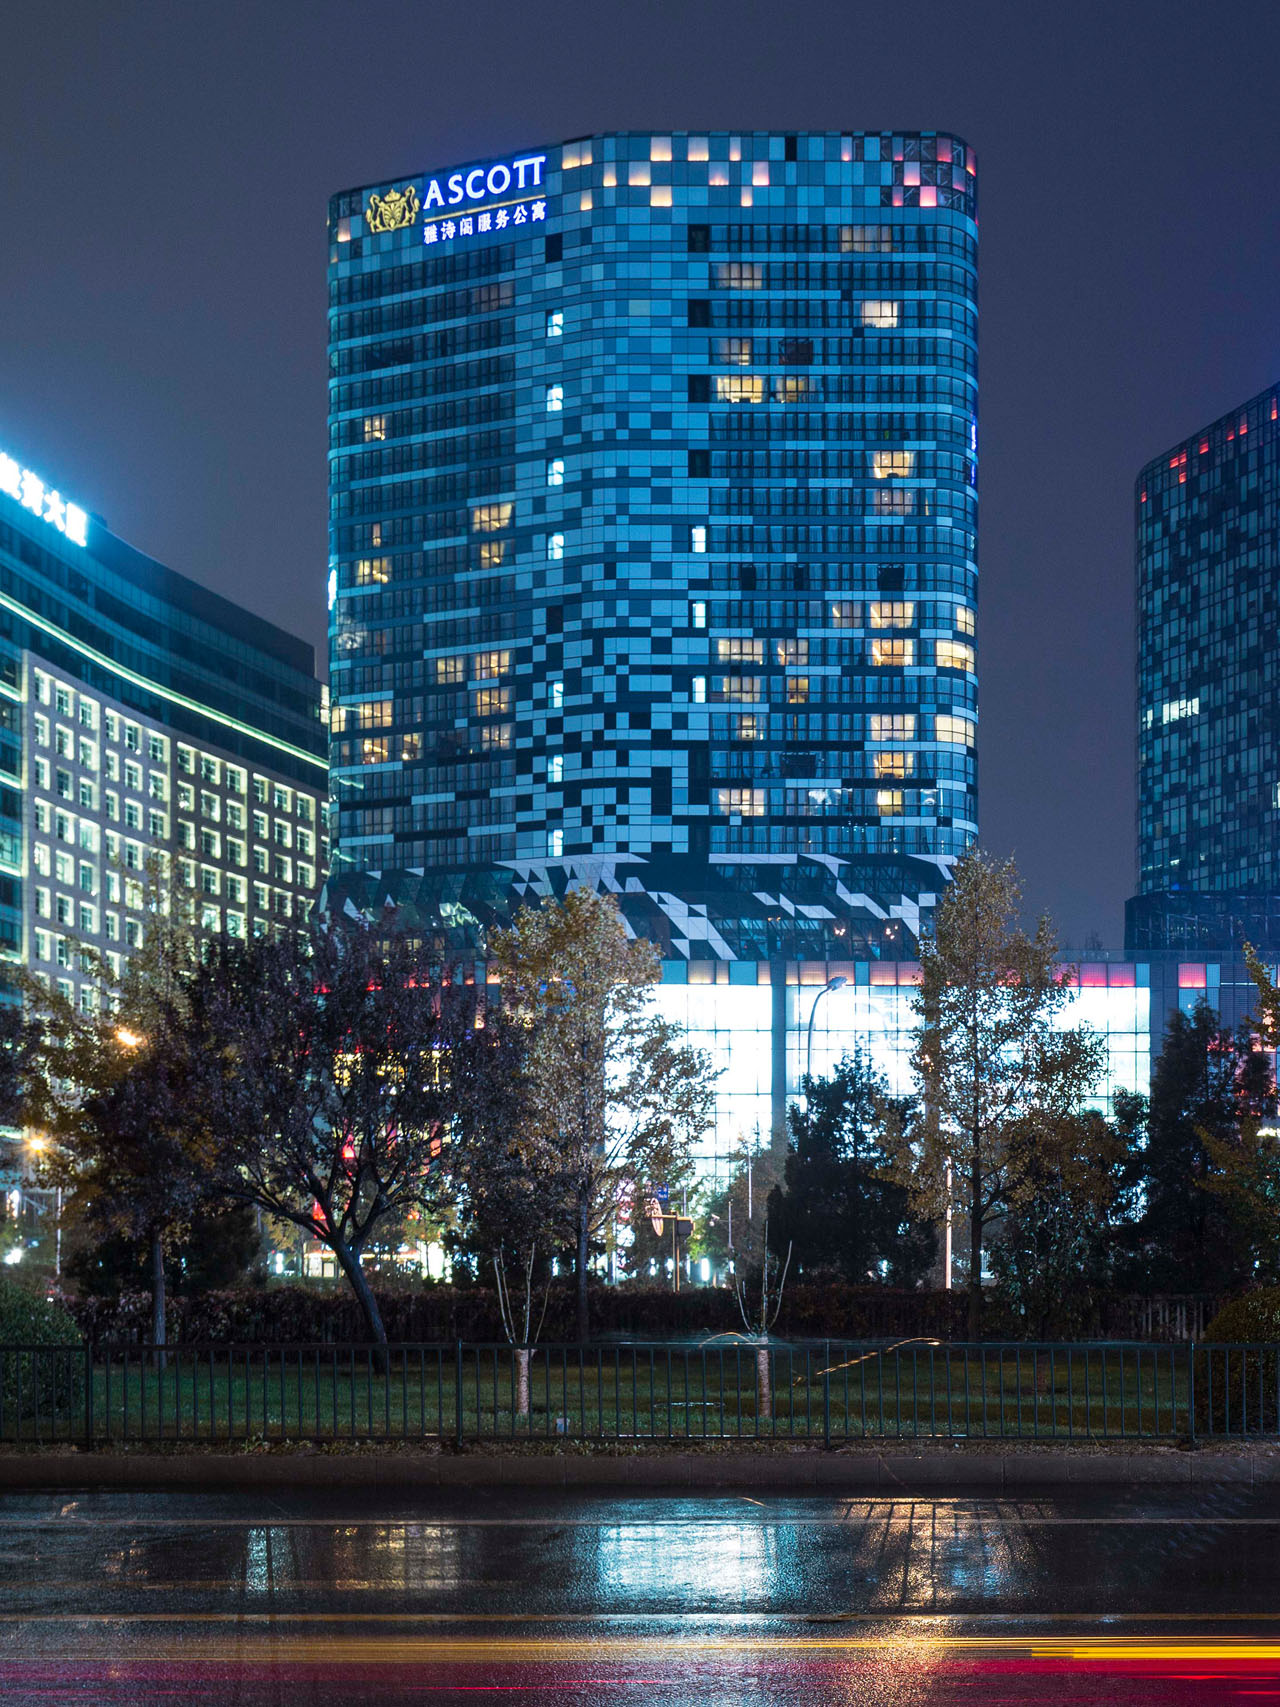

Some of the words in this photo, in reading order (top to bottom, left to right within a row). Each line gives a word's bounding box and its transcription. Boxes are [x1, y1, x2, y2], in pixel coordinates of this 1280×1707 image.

[423, 155, 546, 209] ASCOTT
[423, 201, 546, 244] 雅诗阁服务公寓
